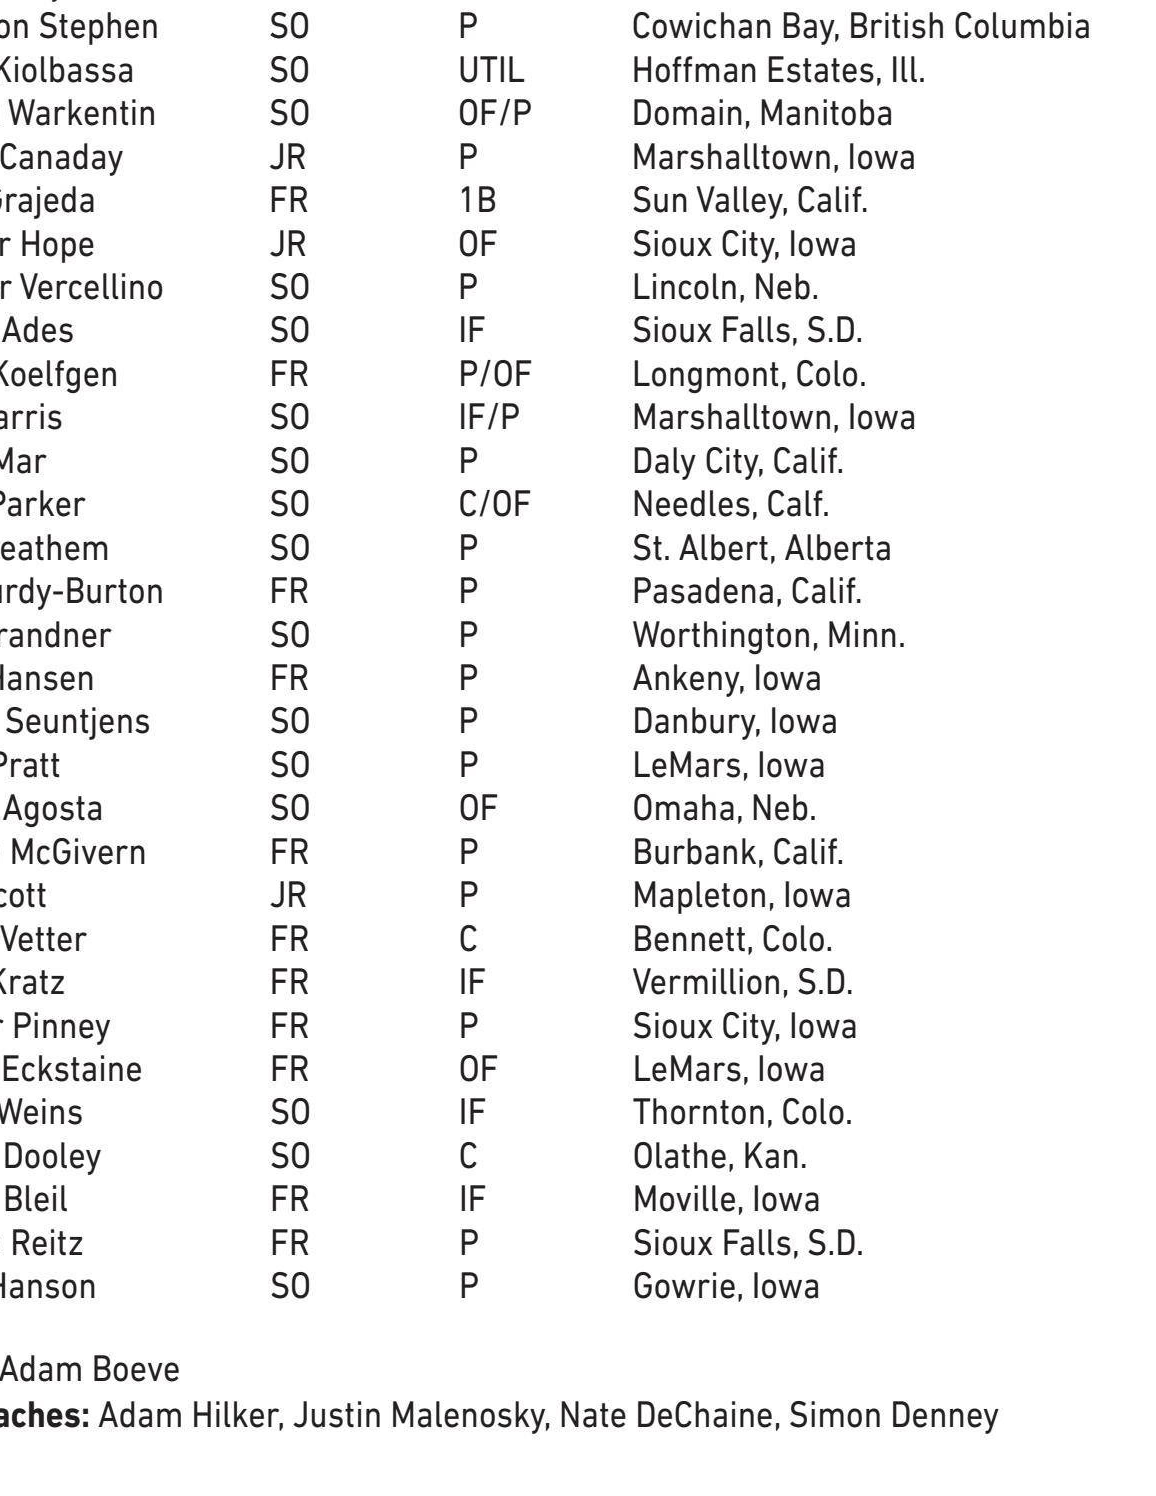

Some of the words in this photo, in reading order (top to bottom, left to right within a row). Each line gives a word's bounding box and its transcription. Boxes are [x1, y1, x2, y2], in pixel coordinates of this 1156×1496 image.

[39, 11, 158, 46] Stephen
[270, 11, 309, 39] SO
[460, 11, 478, 39] P
[633, 11, 771, 39] Cowichan
[783, 11, 840, 46] Bay,
[850, 11, 944, 39] British
[955, 11, 1090, 40] Columbia
[8, 98, 155, 127] Warkentin
[270, 98, 309, 127] SO
[459, 98, 532, 126] OF/P
[633, 98, 750, 130] Domain,
[761, 98, 892, 126] Manitoba
[21, 229, 94, 264] Hope
[269, 229, 306, 257] JR
[459, 229, 498, 257] OF
[633, 229, 713, 257] Sioux
[722, 229, 780, 264] City,
[790, 229, 856, 257] Iowa
[271, 359, 308, 387] FR
[460, 359, 532, 388] P/OF
[634, 359, 787, 394] Longmont,
[796, 359, 866, 387] Colo.
[270, 446, 309, 474] SO
[460, 446, 478, 474] P
[634, 446, 696, 481] Daly
[706, 446, 764, 481] City,
[773, 446, 843, 474] Calif.
[271, 576, 308, 604] FR
[460, 576, 478, 604] P
[634, 576, 782, 608] Pasadena,
[792, 576, 861, 604] Calif.
[5, 706, 150, 741] Seuntjens
[271, 706, 310, 734] SO
[460, 706, 478, 734] P
[634, 706, 761, 741] Danbury,
[771, 706, 837, 735] Iowa
[2, 793, 102, 828] Agosta
[270, 793, 310, 821] SO
[460, 793, 498, 821] OF
[633, 793, 743, 825] Omaha,
[753, 793, 816, 821] Neb.
[0, 924, 88, 952] Vetter
[271, 924, 309, 952] FR
[460, 924, 477, 952] C
[634, 924, 753, 956] Bennett,
[763, 924, 832, 952] Colo.
[3, 1054, 142, 1082] Eckstaine
[272, 1054, 309, 1082] FR
[460, 1054, 498, 1082] OF
[634, 1054, 749, 1086] LeMars,
[759, 1054, 824, 1082] Iowa
[4, 1141, 102, 1176] Dooley
[271, 1141, 310, 1169] SO
[460, 1141, 477, 1169] C
[634, 1141, 734, 1173] Olathe,
[744, 1141, 806, 1169] Kan.
[271, 1271, 310, 1299] SO
[461, 1271, 479, 1299] P
[634, 1271, 743, 1303] Gowrie,
[753, 1271, 819, 1299] Iowa
[93, 1354, 180, 1383] Boeve
[98, 1400, 182, 1428] Adam
[193, 1400, 284, 1432] Hilker,
[293, 1400, 381, 1428] Justin
[392, 1400, 550, 1435] Malenosky,
[561, 1400, 626, 1429] Nate
[637, 1400, 780, 1432] DeChaine,
[789, 1400, 881, 1429] Simon
[892, 1400, 999, 1435] Denney
